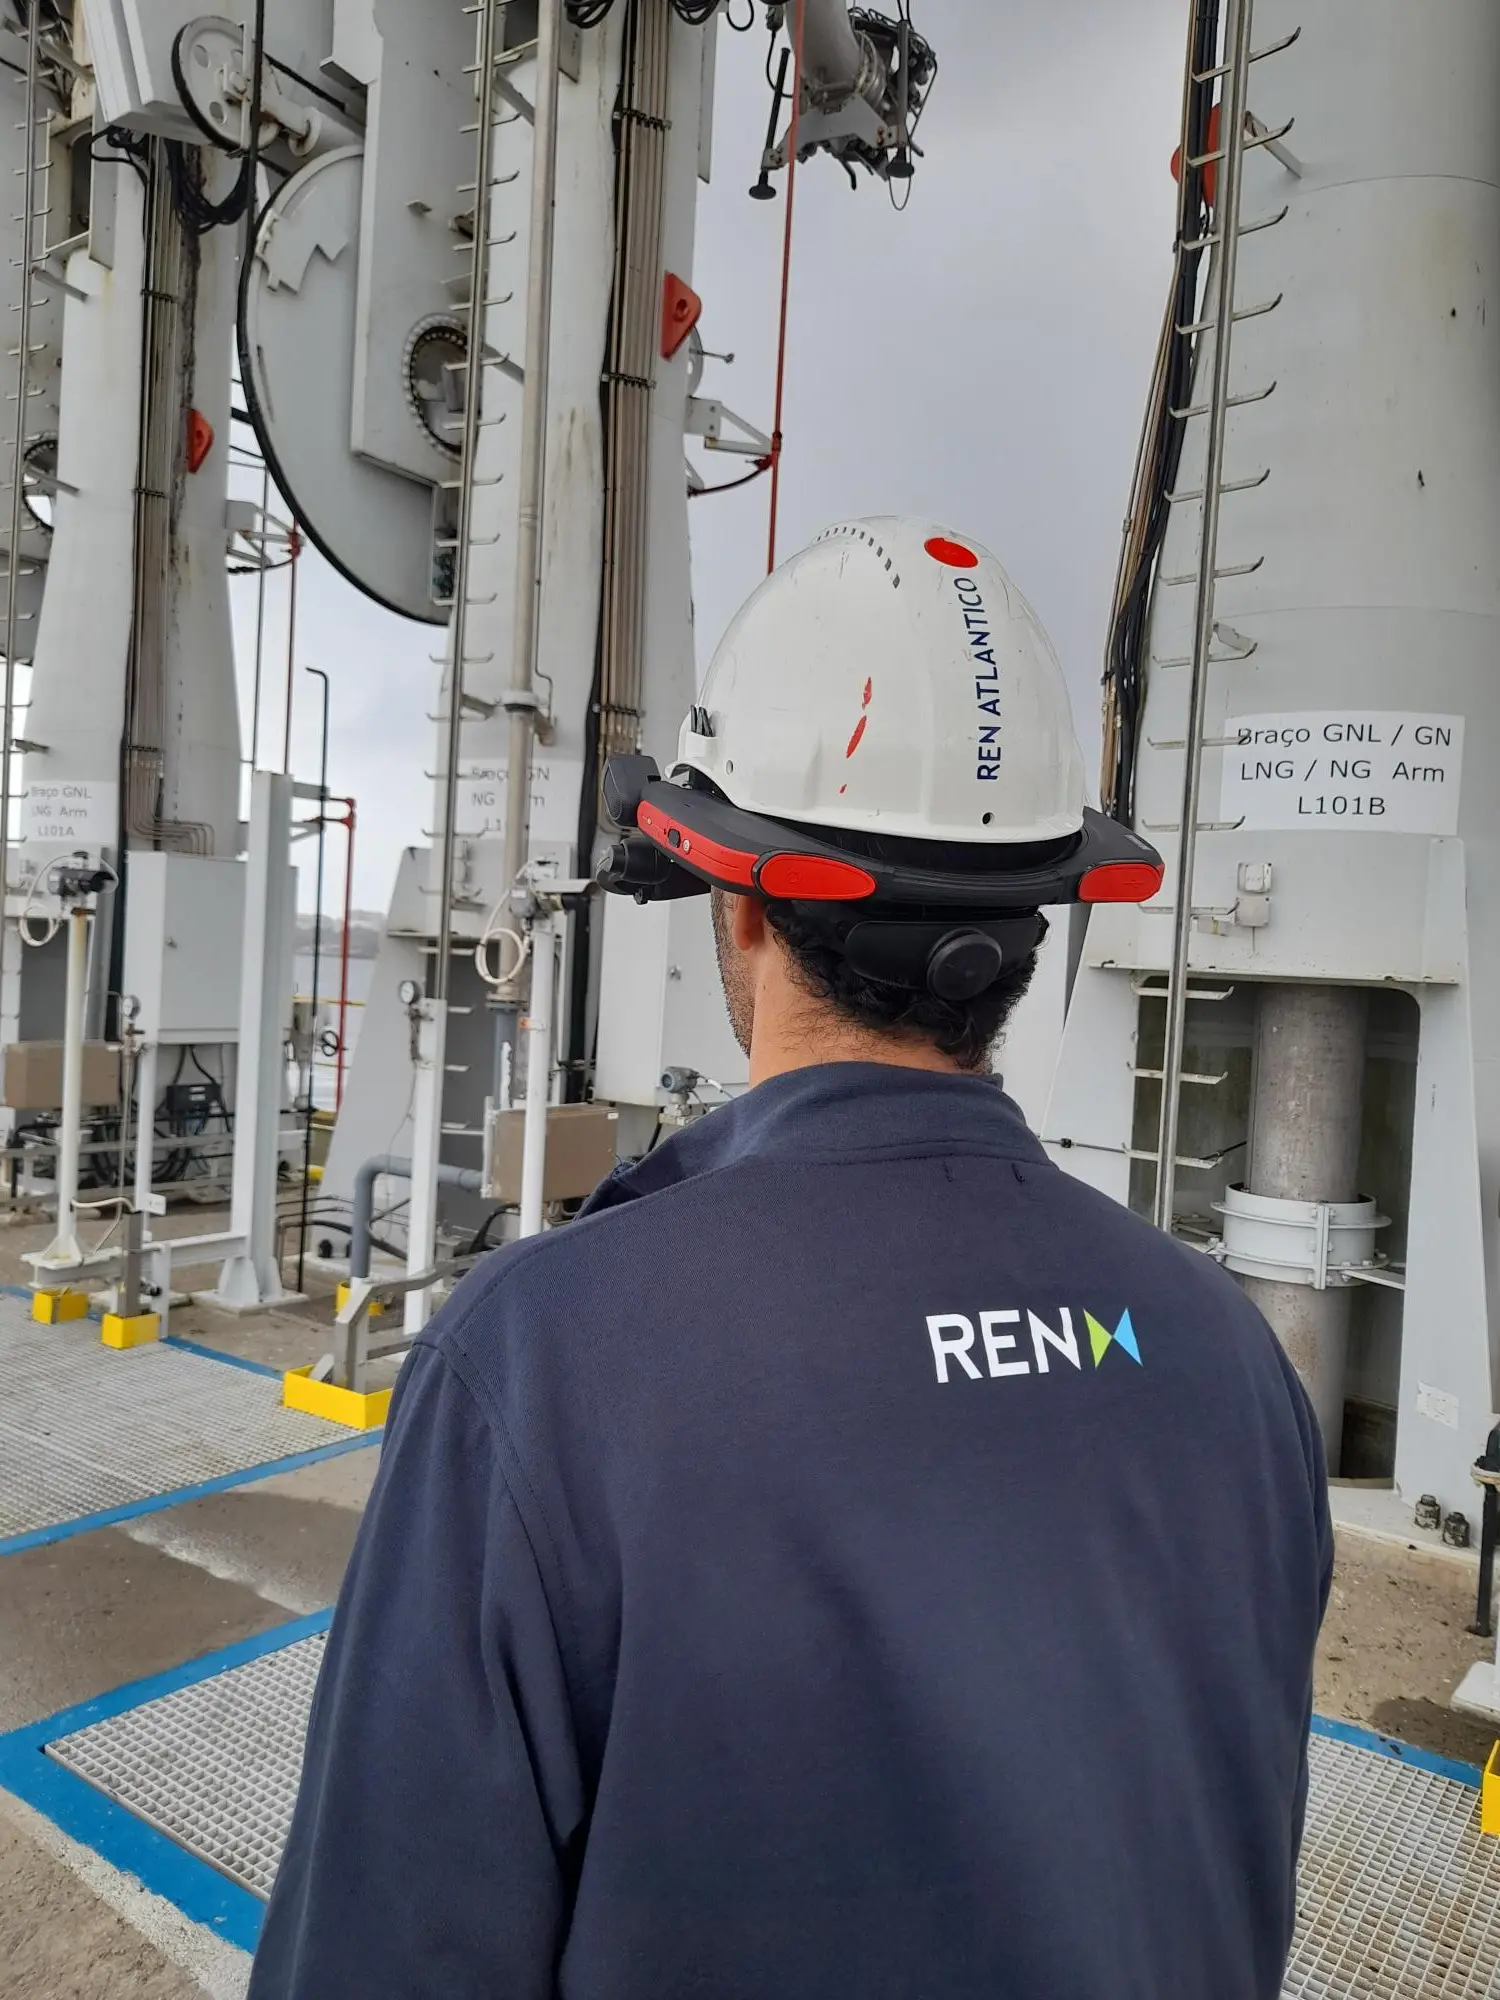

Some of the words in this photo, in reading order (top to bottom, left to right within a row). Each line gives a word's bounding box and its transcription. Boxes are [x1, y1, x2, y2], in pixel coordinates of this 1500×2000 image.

[953, 577, 1002, 717] ATLANTICO
[1238, 728, 1311, 748] Braço
[1323, 723, 1382, 743] GNL
[1391, 724, 1404, 746] /
[1415, 726, 1451, 746] GN
[976, 725, 1002, 780] REN
[1241, 760, 1295, 780] LNG
[1304, 759, 1318, 781] /
[1330, 760, 1371, 779] NG
[1392, 762, 1444, 782] Arm
[63, 785, 93, 799] GNL
[59, 806, 88, 818] Arm
[1298, 796, 1386, 816] L101B
[925, 1306, 1082, 1384] REN
